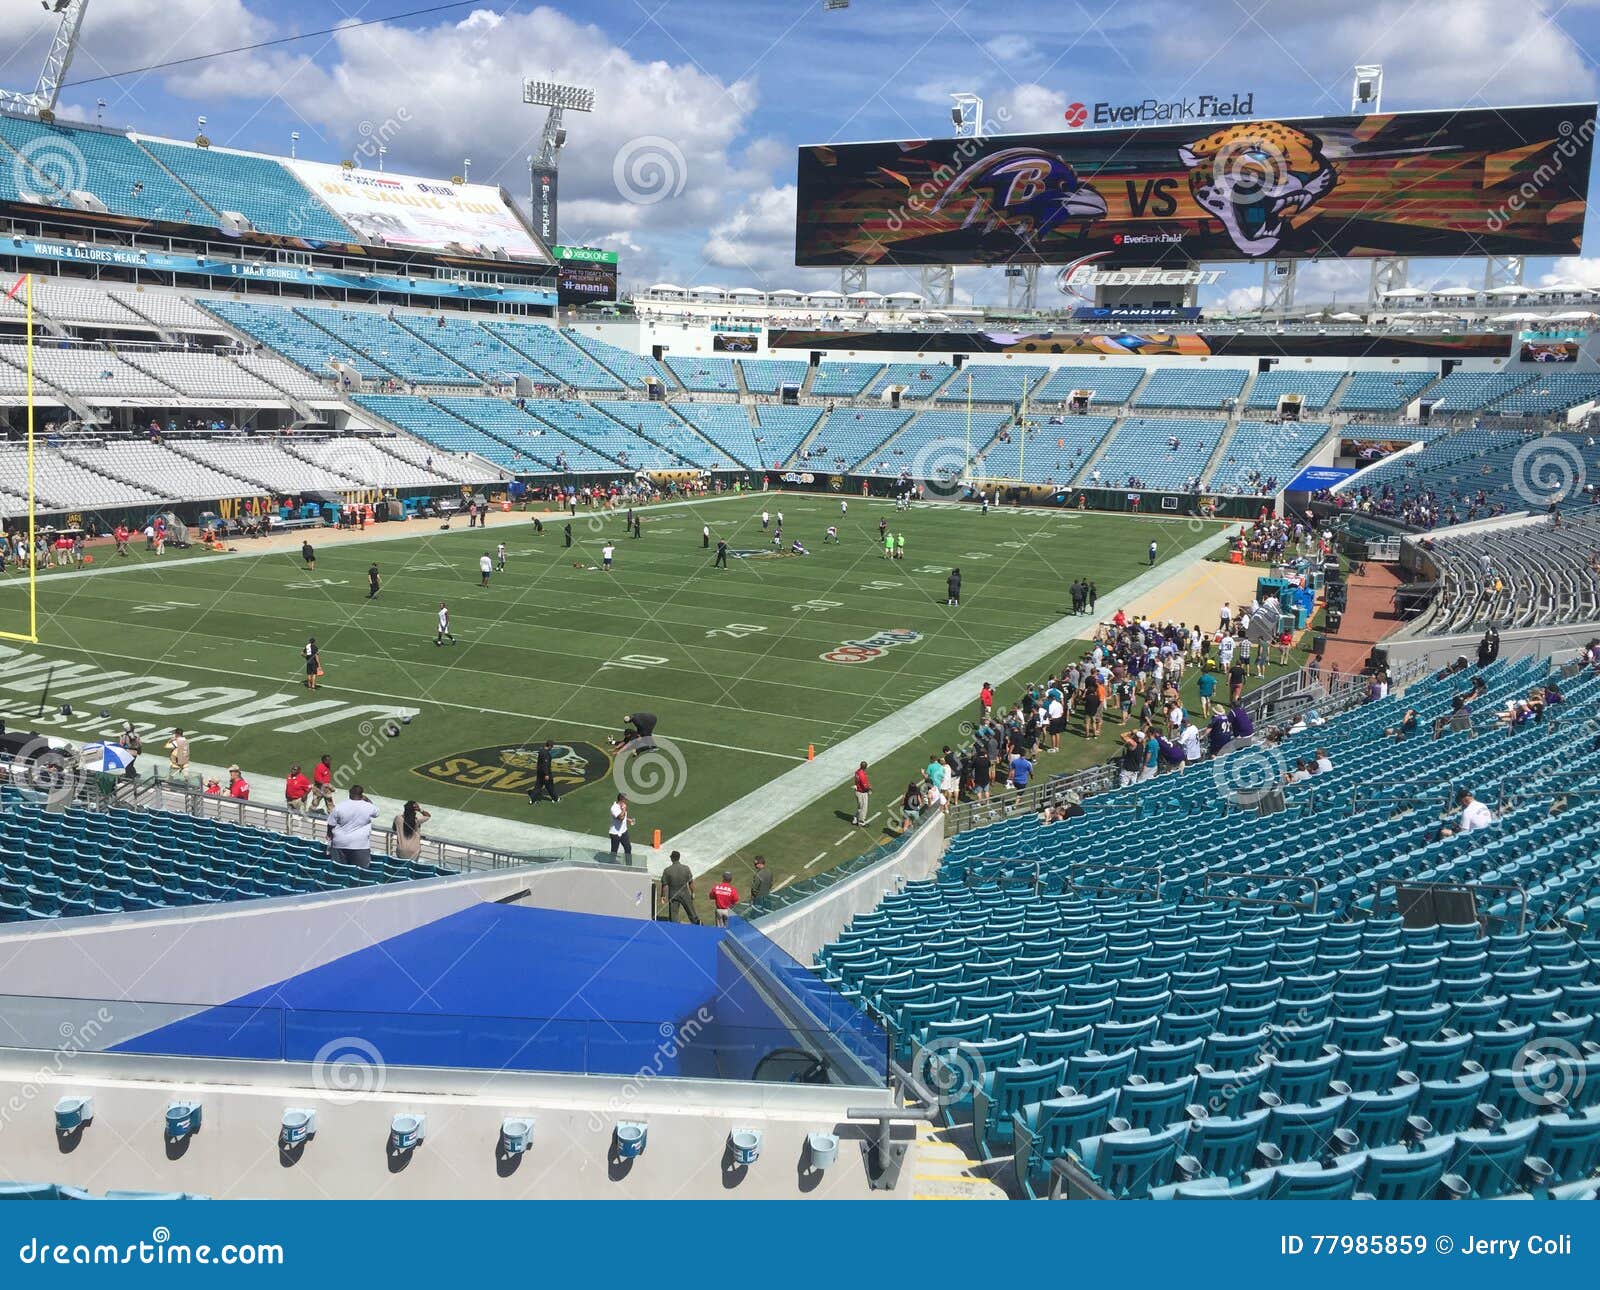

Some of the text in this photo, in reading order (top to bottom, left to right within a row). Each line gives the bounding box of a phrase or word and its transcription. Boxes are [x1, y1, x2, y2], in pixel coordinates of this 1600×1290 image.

[1093, 93, 1254, 124] EverBank Field
[1126, 178, 1178, 217] VS
[1161, 234, 1182, 243] Field
[34, 244, 65, 256] WAYNE
[66, 248, 73, 257] &
[75, 248, 111, 261] DELORES
[113, 252, 147, 265] WEAVER
[573, 249, 609, 261] XBOX ONE
[231, 265, 237, 274] 8
[267, 269, 299, 280] BRUNELL
[1111, 308, 1180, 316] FANDUEL
[705, 623, 768, 638] 20
[599, 654, 670, 671] 10
